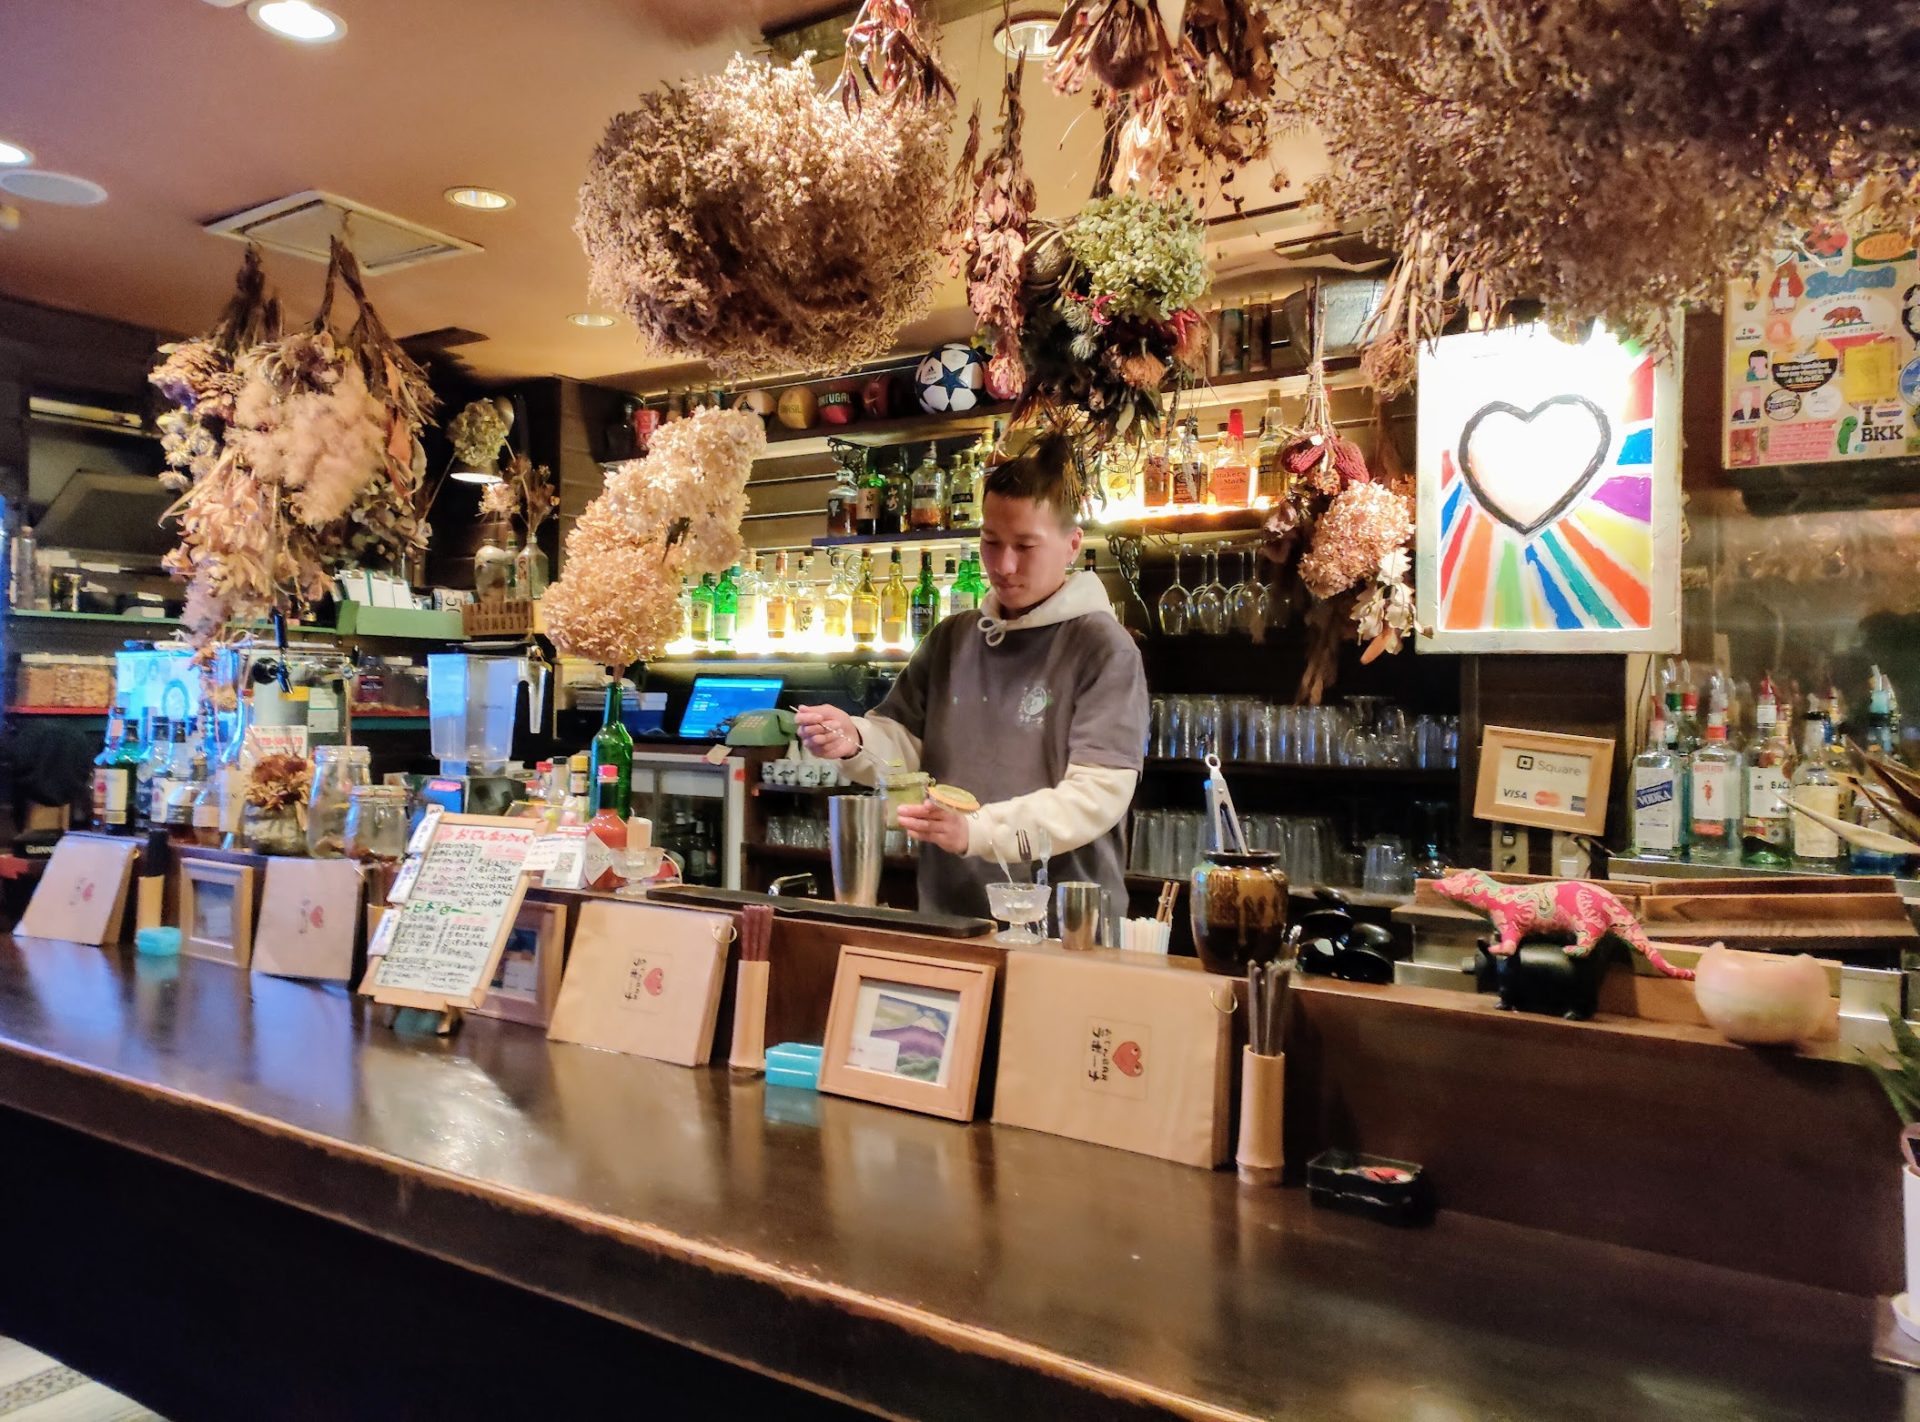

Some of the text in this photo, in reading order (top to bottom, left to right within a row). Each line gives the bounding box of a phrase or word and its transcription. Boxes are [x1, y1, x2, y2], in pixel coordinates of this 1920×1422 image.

[1861, 424, 1904, 443] BKK
[1537, 760, 1582, 777] Square
[1503, 788, 1528, 800] VISA
[1637, 790, 1671, 806] VODKA
